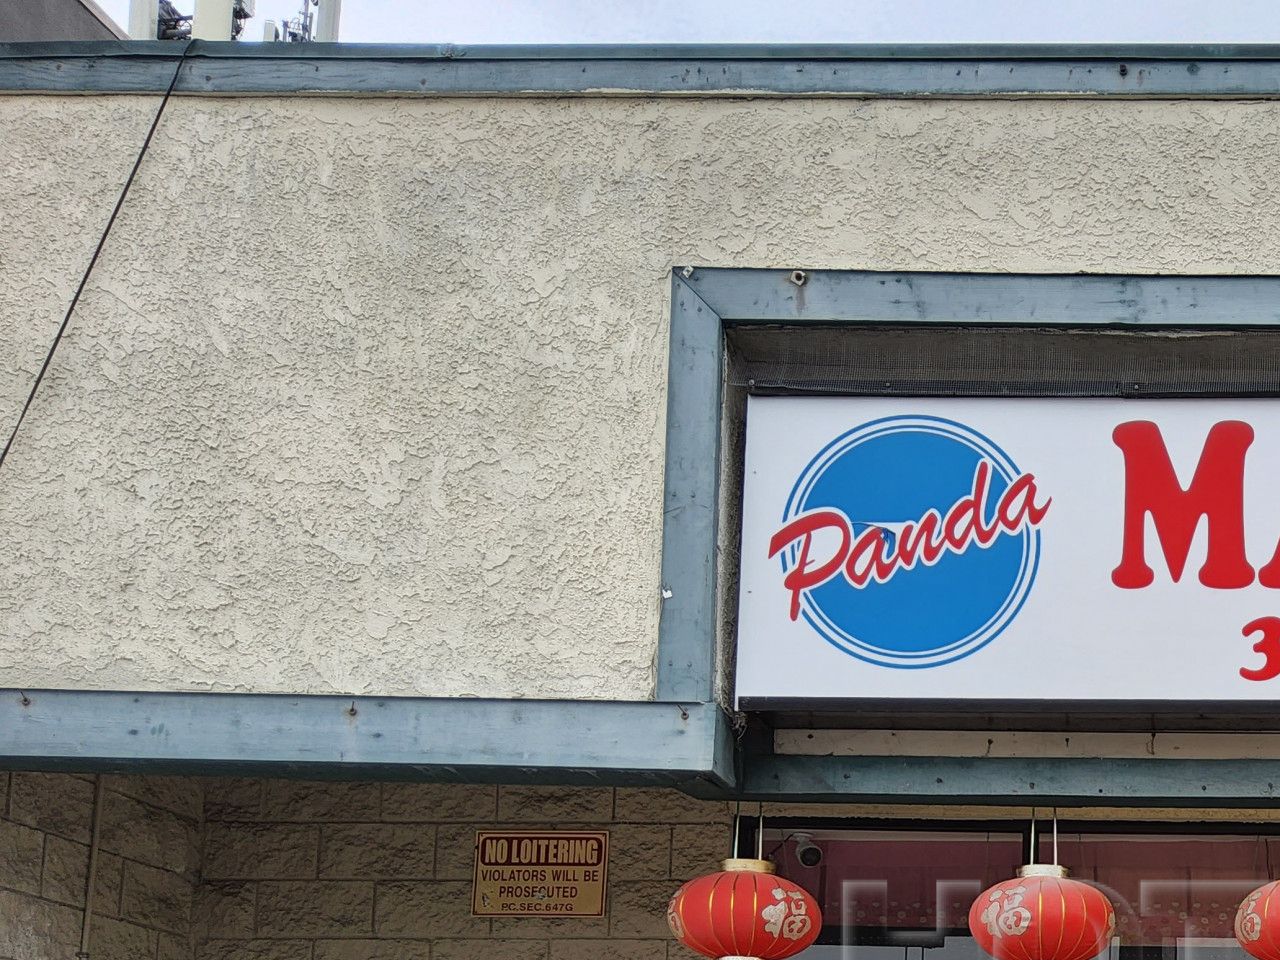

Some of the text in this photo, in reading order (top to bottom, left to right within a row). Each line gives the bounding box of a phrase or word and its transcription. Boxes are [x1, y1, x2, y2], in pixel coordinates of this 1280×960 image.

[768, 460, 1052, 621] Panda
[485, 838, 599, 864] NO LOITERING
[481, 869, 599, 882] VIOLATORS WILL BE
[499, 886, 578, 898] PROSECUTED
